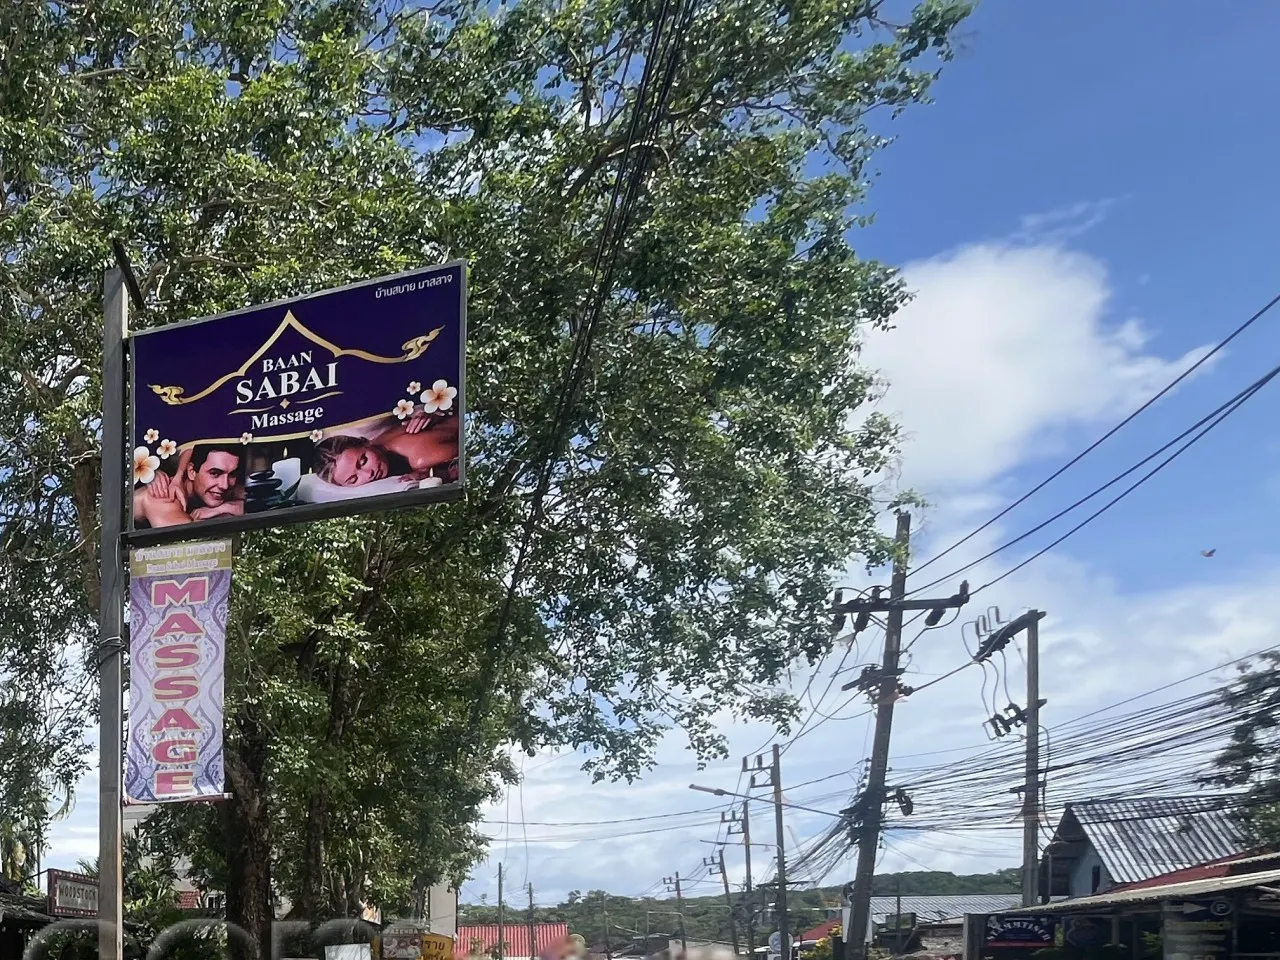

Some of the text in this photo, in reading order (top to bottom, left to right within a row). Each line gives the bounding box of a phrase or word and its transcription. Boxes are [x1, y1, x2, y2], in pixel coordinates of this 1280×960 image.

[375, 282, 416, 299] บ้านสบาย
[262, 350, 313, 374] BAAN
[236, 361, 339, 405] SABAI
[251, 406, 324, 430] Massage
[150, 576, 209, 796] MASSAGE
[58, 884, 97, 901] WOODSTOCK
